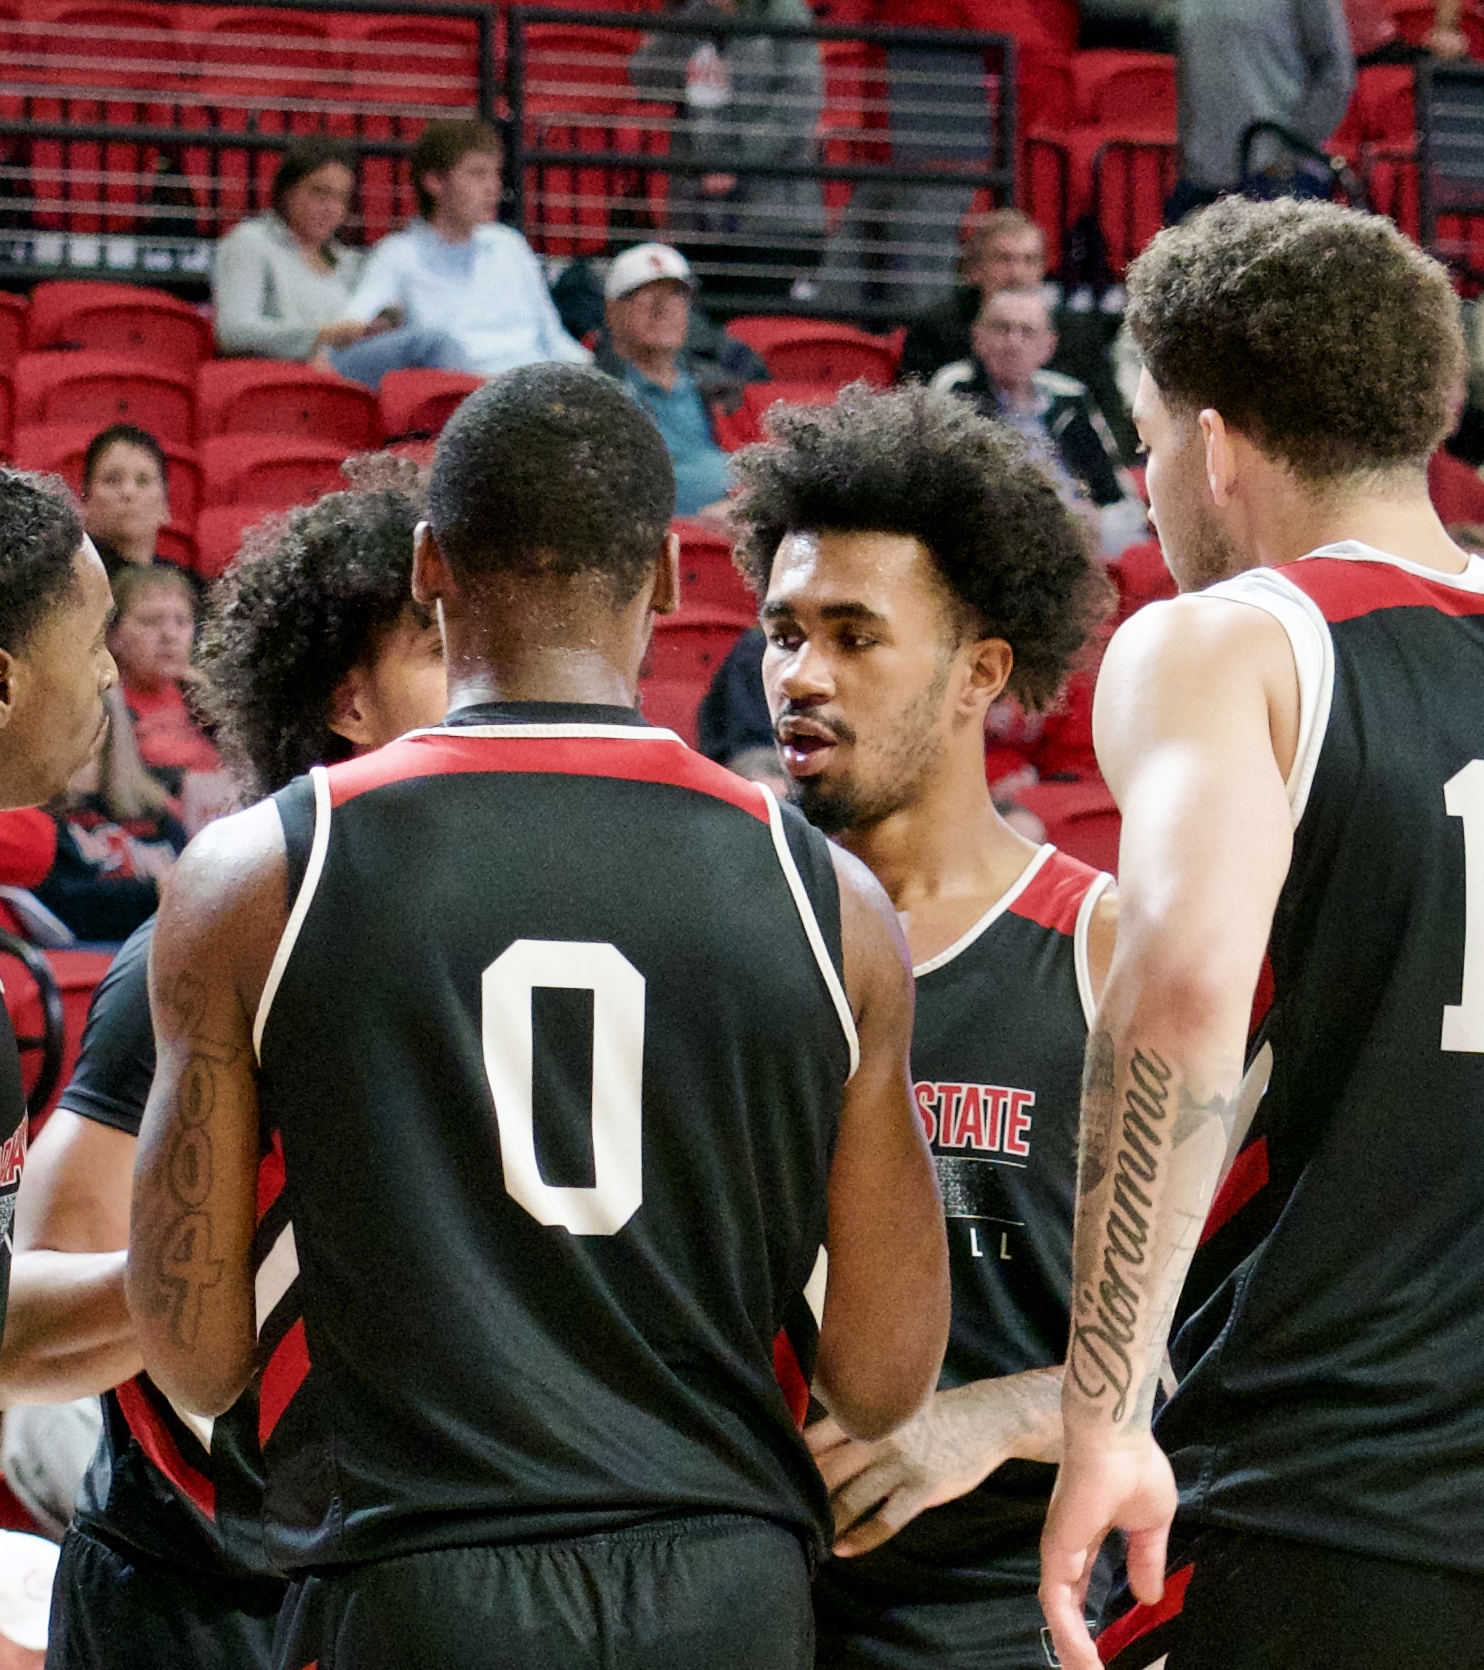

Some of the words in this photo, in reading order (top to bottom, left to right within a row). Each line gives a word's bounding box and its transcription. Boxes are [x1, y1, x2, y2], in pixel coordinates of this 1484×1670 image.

[481, 939, 645, 1236] 0
[913, 1081, 1036, 1157] STATE
[1071, 1046, 1173, 1424] Dioramma
